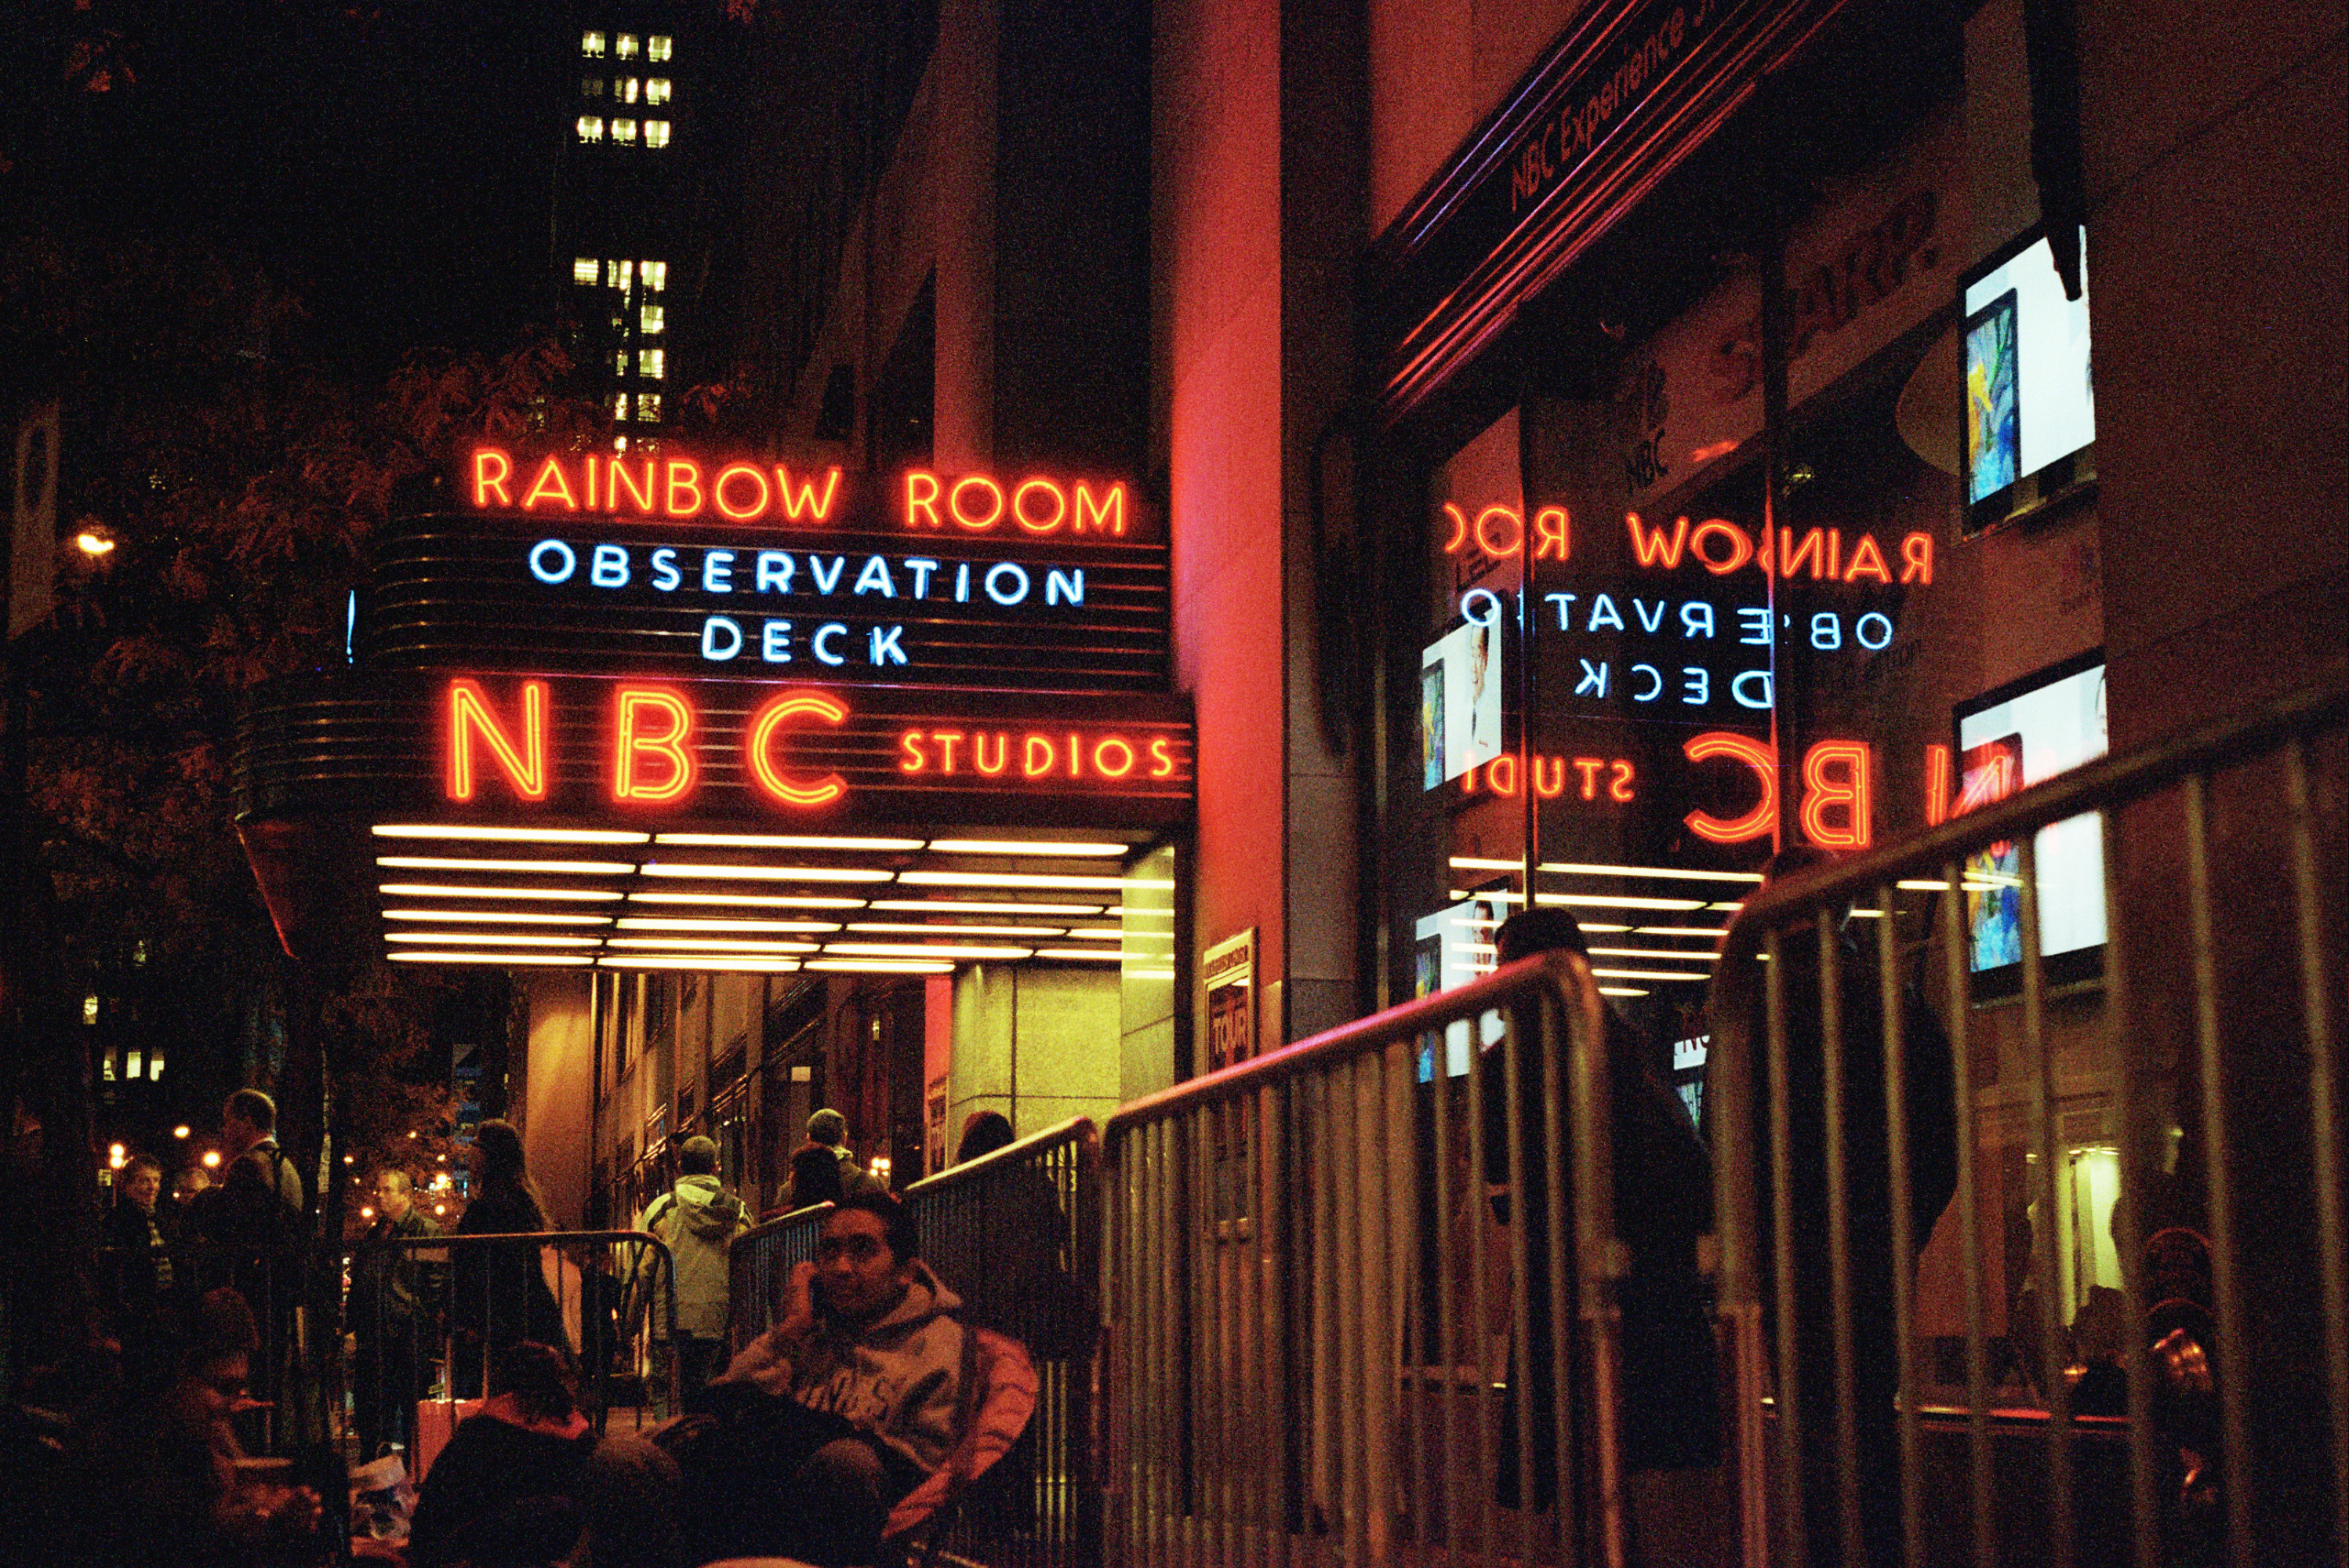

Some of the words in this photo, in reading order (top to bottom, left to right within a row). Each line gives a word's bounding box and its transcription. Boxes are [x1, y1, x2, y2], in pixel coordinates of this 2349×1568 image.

[1511, 122, 1556, 213] NBC
[1559, 6, 1685, 163] Experience
[473, 448, 841, 523] RAINBOW
[905, 469, 1127, 535] ROOM
[528, 539, 1085, 607] OBSERVATION
[701, 615, 909, 666] DECK
[447, 679, 850, 808] NBC
[900, 729, 1175, 779] STUDIOS
